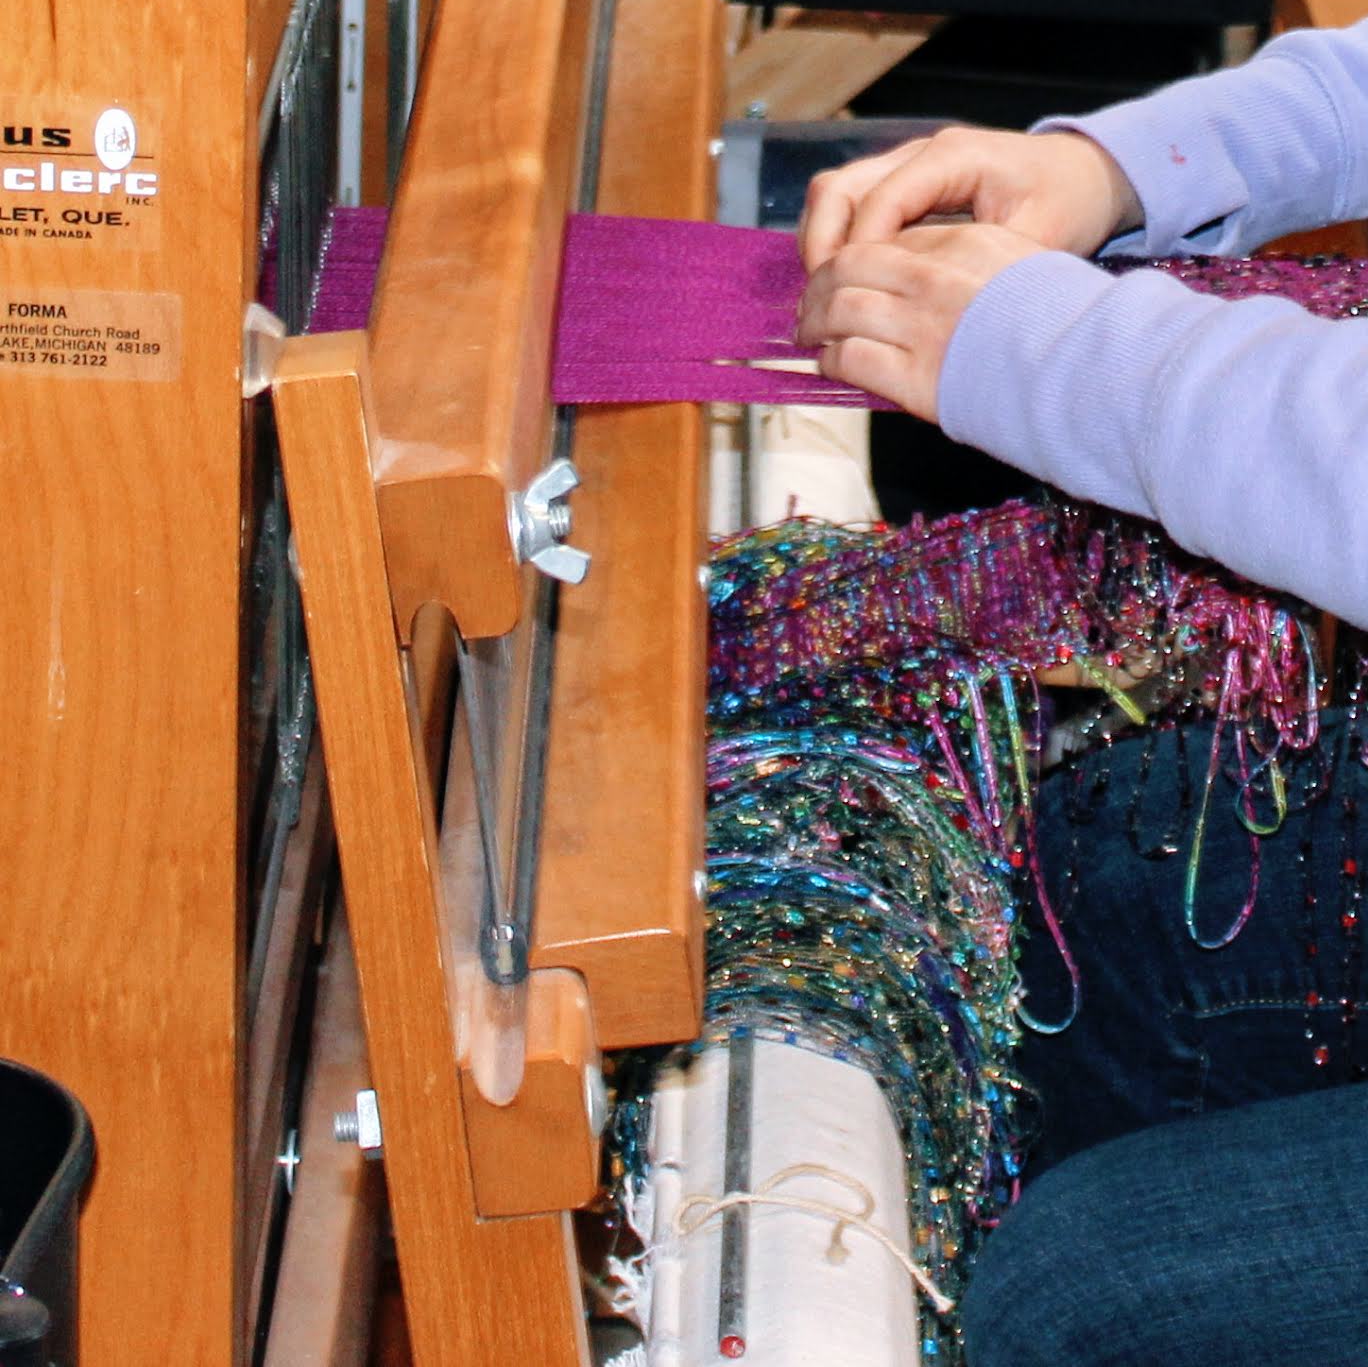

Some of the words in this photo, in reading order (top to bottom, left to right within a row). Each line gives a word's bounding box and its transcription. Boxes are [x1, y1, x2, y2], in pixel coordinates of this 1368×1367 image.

[4, 126, 71, 147] us
[3, 161, 157, 195] clerc
[62, 209, 130, 226] QUE.
[24, 228, 36, 237] IN
[42, 229, 92, 239] CANADA
[8, 303, 67, 319] FORMA
[53, 325, 101, 338] Church
[106, 327, 140, 340] Road
[116, 342, 160, 355] 48189
[10, 351, 36, 363] 313
[41, 352, 107, 367] 761-2122
